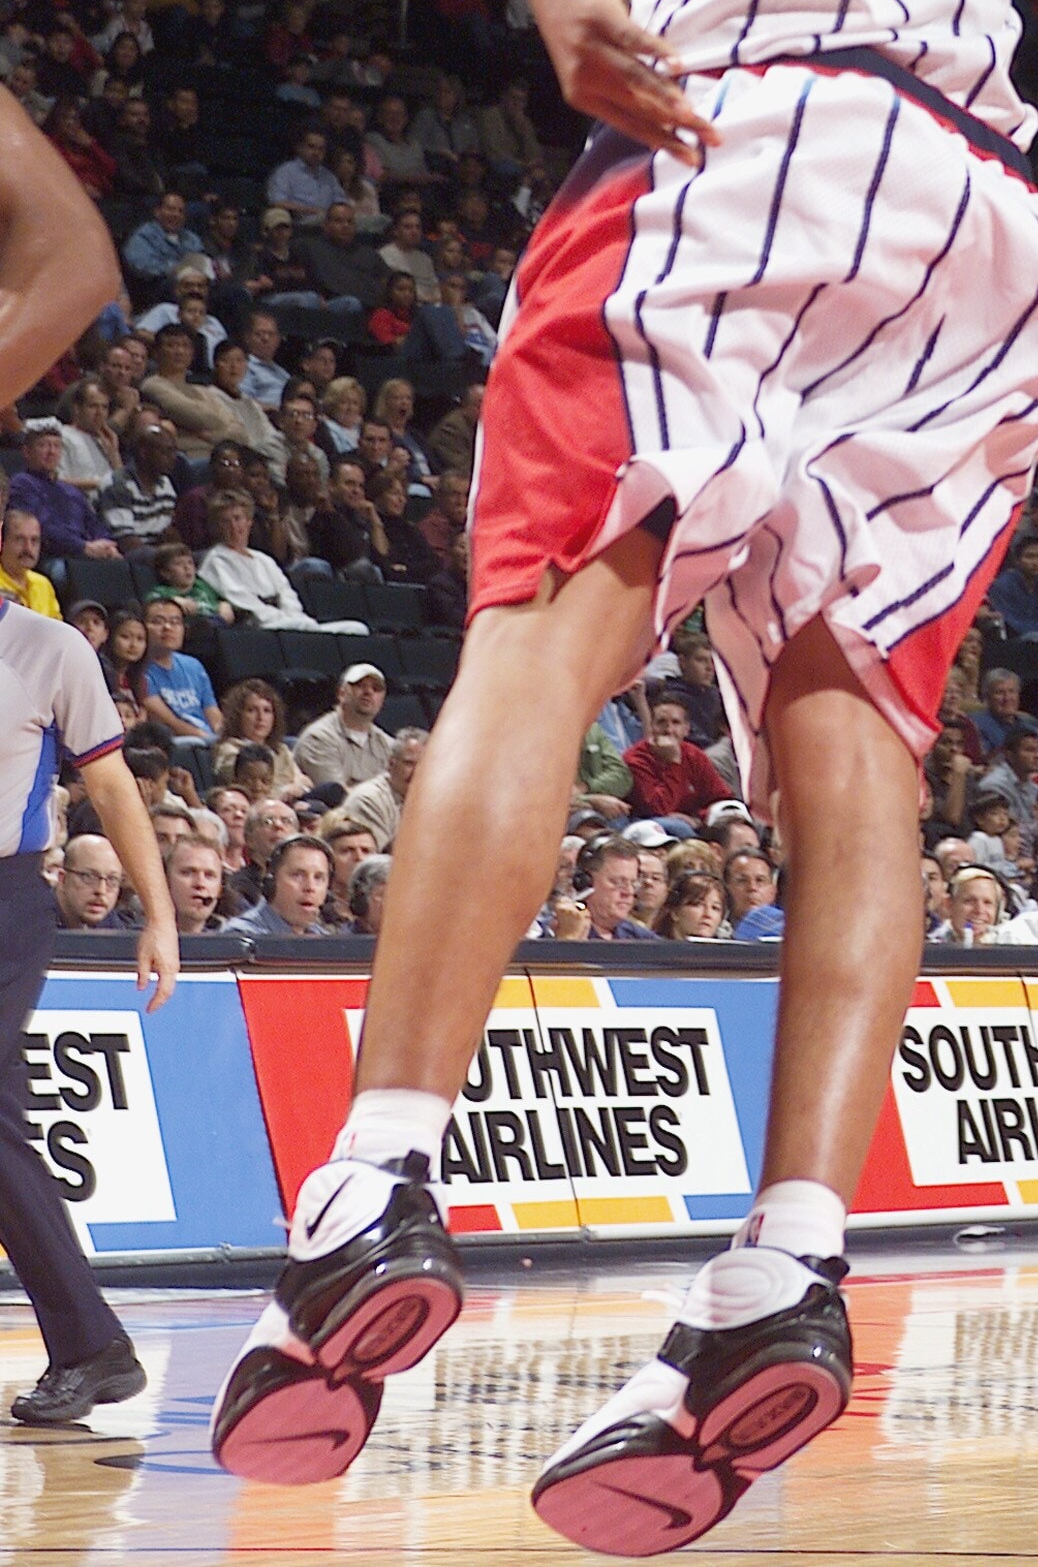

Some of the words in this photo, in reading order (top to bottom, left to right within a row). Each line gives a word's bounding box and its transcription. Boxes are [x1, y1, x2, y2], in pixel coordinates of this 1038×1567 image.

[20, 1031, 131, 1112] EST
[461, 1026, 711, 1102] UTHWEST
[441, 1105, 689, 1185] AIRLINES
